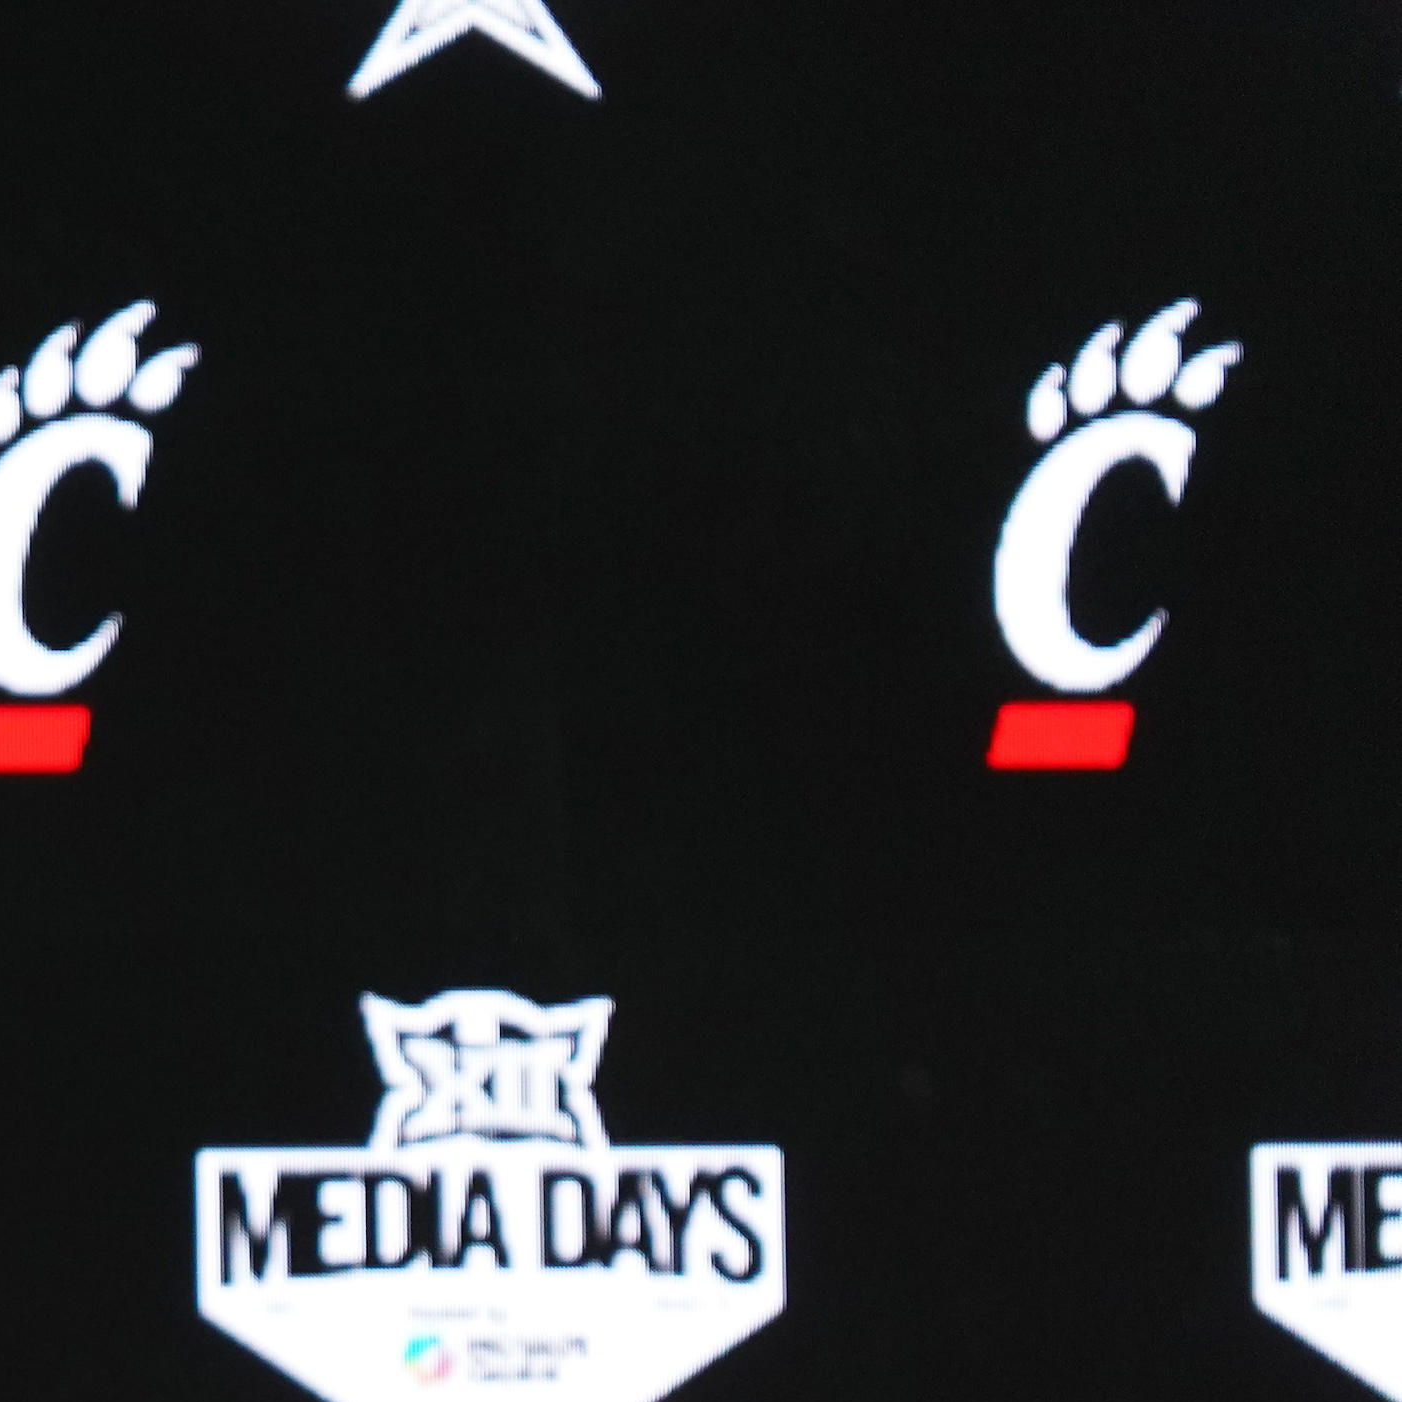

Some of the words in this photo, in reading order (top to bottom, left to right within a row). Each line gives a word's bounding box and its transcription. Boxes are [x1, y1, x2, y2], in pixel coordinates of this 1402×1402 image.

[994, 409, 1198, 695] C
[218, 1168, 511, 1288] MEDIA
[539, 1166, 763, 1285] DAYS
